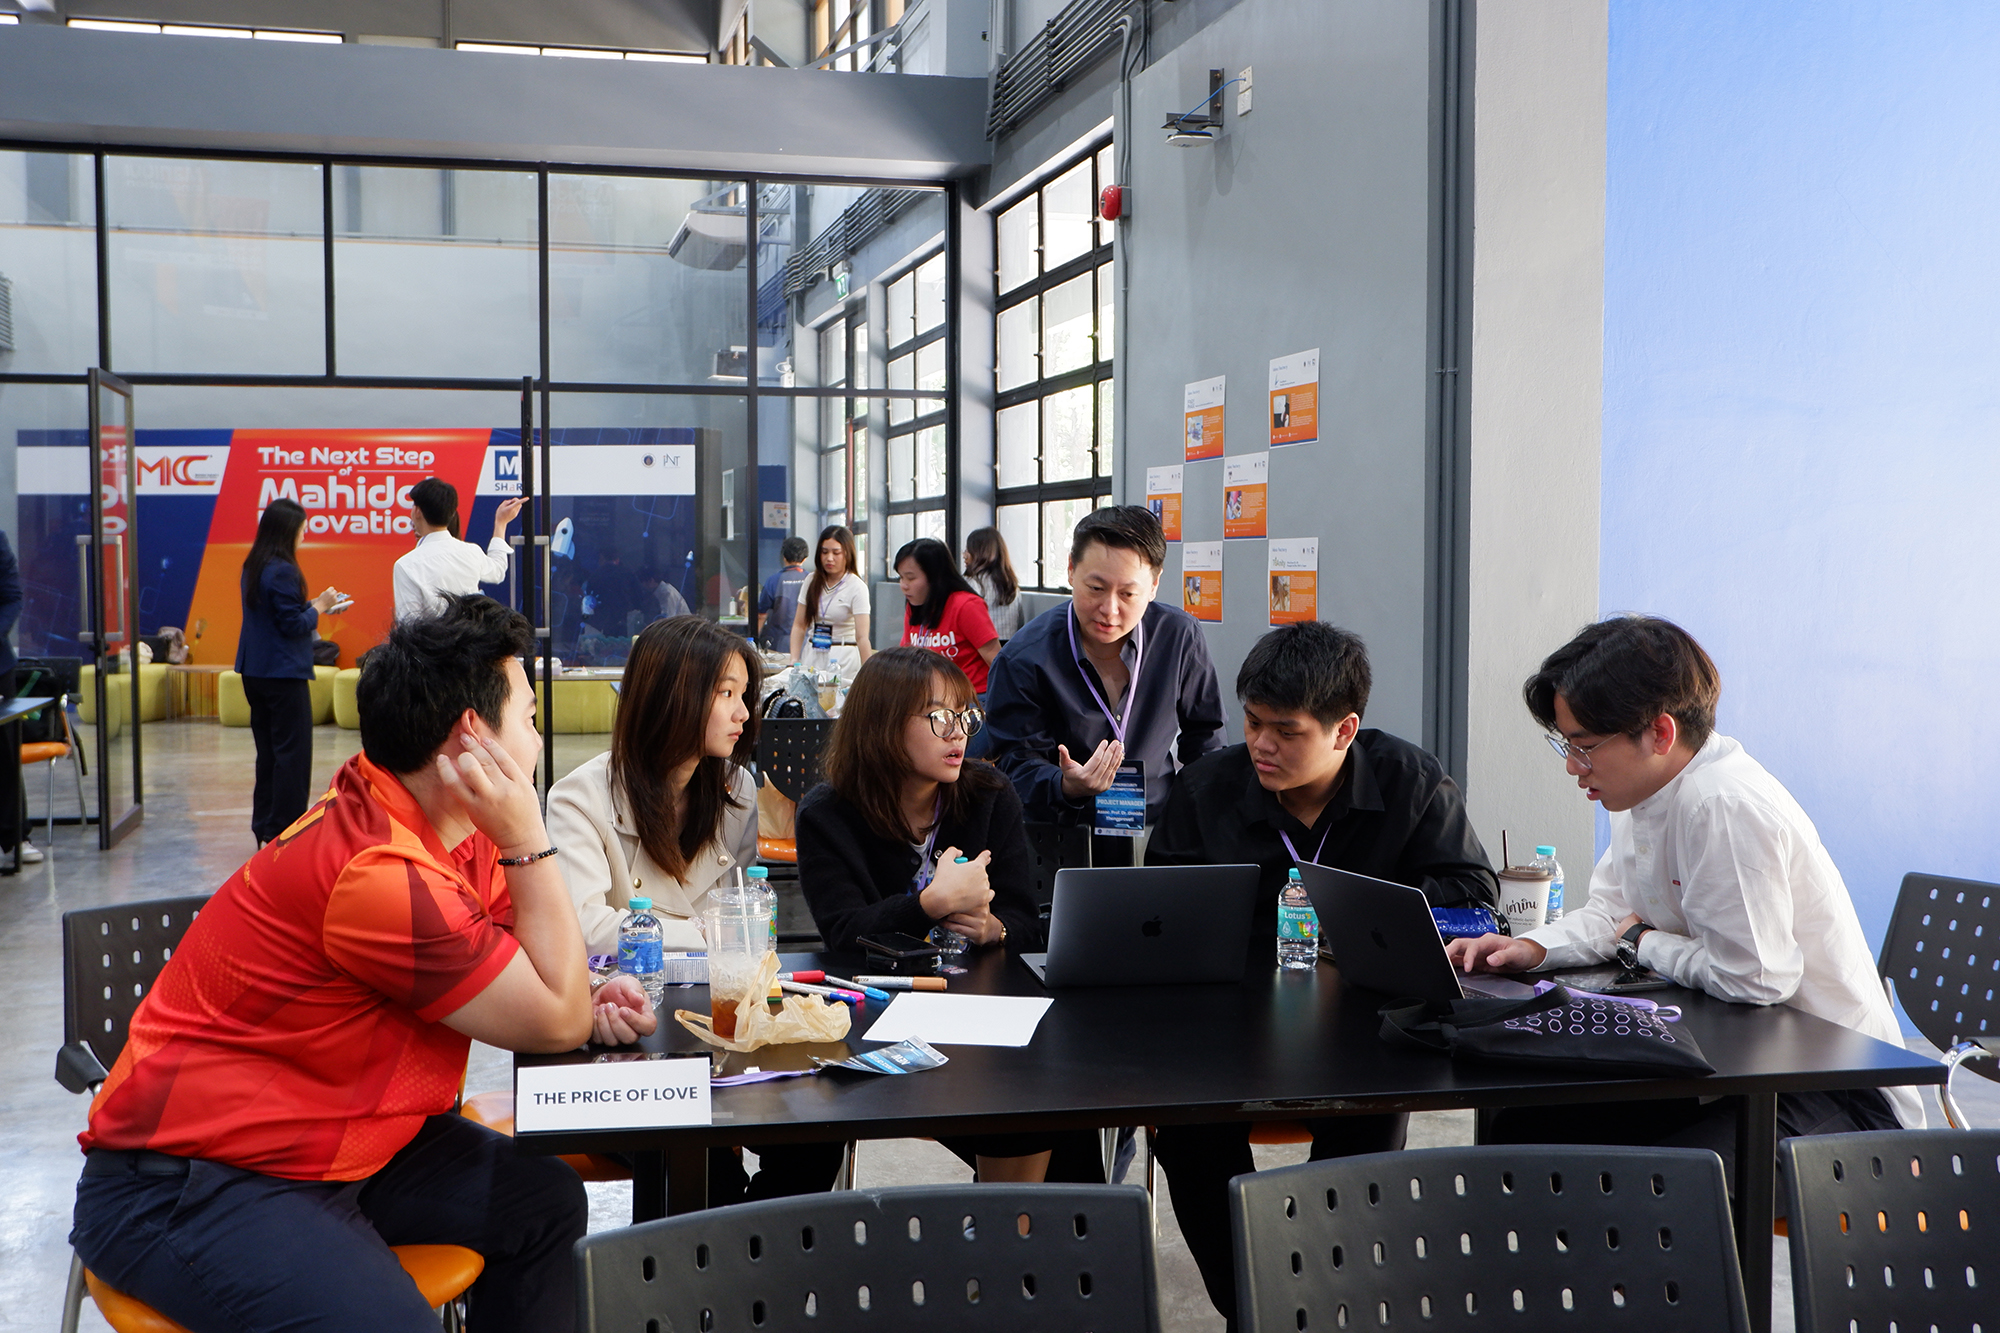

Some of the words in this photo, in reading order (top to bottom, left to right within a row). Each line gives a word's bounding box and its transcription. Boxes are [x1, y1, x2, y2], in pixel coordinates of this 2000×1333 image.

[258, 446, 305, 465] The
[311, 447, 369, 465] Next
[376, 447, 435, 469] Step
[338, 466, 353, 476] of
[258, 475, 434, 509] Mahido
[534, 1092, 566, 1105] THE
[571, 1090, 622, 1103] PRICE
[626, 1088, 649, 1101] OF
[654, 1086, 698, 1101] LOVE
